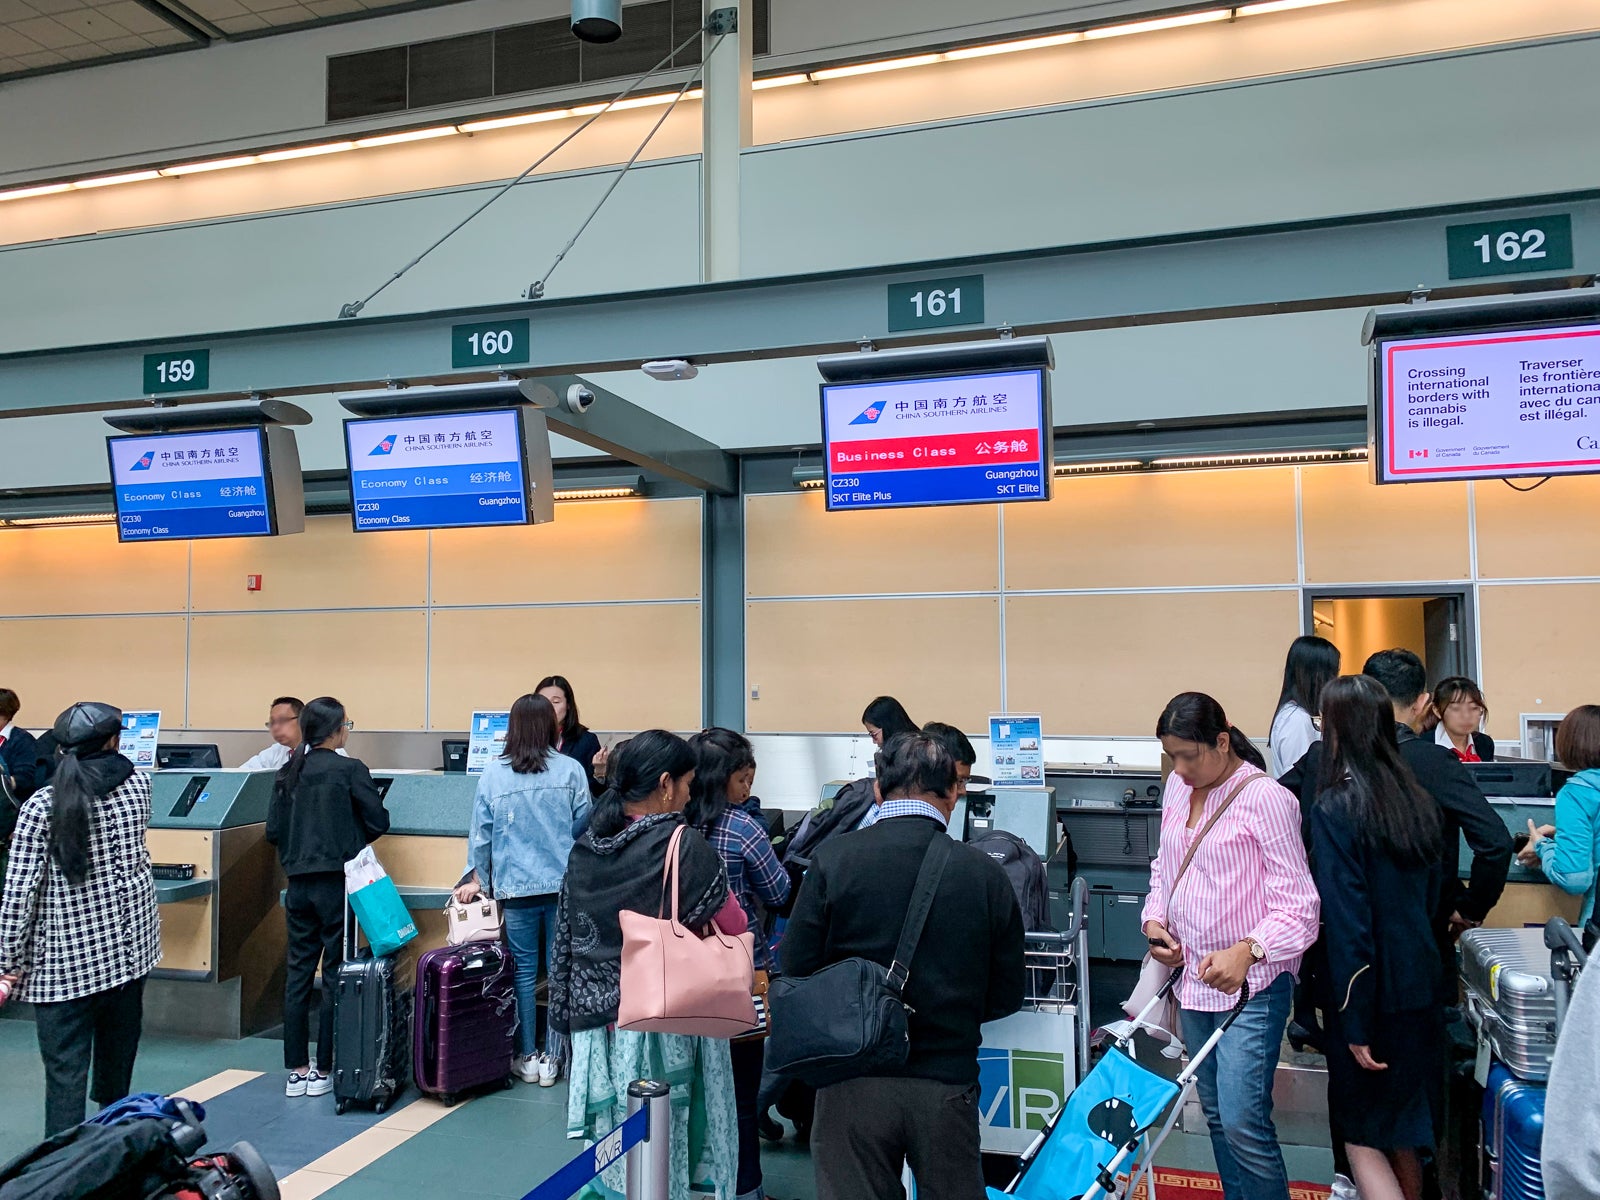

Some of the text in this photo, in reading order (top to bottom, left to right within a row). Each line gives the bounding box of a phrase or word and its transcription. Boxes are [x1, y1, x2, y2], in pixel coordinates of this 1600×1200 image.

[1473, 228, 1547, 264] 162
[910, 287, 961, 318] 161
[467, 330, 513, 356] 160
[156, 358, 196, 383] 159
[1519, 359, 1583, 370] Traverser
[1408, 366, 1466, 379] Crossing
[1519, 373, 1539, 383] les
[1408, 376, 1489, 391] international
[895, 393, 1008, 412] 中国南方航空
[1408, 389, 1490, 403] borders with
[1519, 399, 1551, 409] avec
[1555, 396, 1572, 406] du
[895, 406, 1008, 420] CHINA SOUTHERN AIRLINES
[1408, 403, 1467, 415] cannabis
[1519, 408, 1588, 421] est illégal.
[1408, 415, 1464, 428] is illegal.
[403, 430, 493, 445] 中国南方航空
[161, 447, 239, 461] 中国南方航空
[975, 439, 1029, 456] 公务舱
[837, 446, 957, 463] Business Class
[469, 470, 512, 484] 经济舱
[985, 468, 1039, 481] Guangzhou
[361, 476, 449, 489] Economy Class
[832, 478, 860, 488] CZ330
[996, 483, 1040, 494] SKT Elite
[124, 490, 202, 502] Economy Class
[219, 485, 257, 498] 经济舱
[832, 491, 892, 503] SKT Elite Plus
[357, 503, 380, 512] CZ330
[478, 496, 521, 507] Guangzhou
[121, 515, 142, 523] CZ330
[228, 509, 265, 519] Guangzhou
[359, 514, 411, 525] Economy Class
[123, 526, 169, 536] Economy Class
[978, 1085, 1060, 1131] VR
[595, 1139, 623, 1166] YVR
